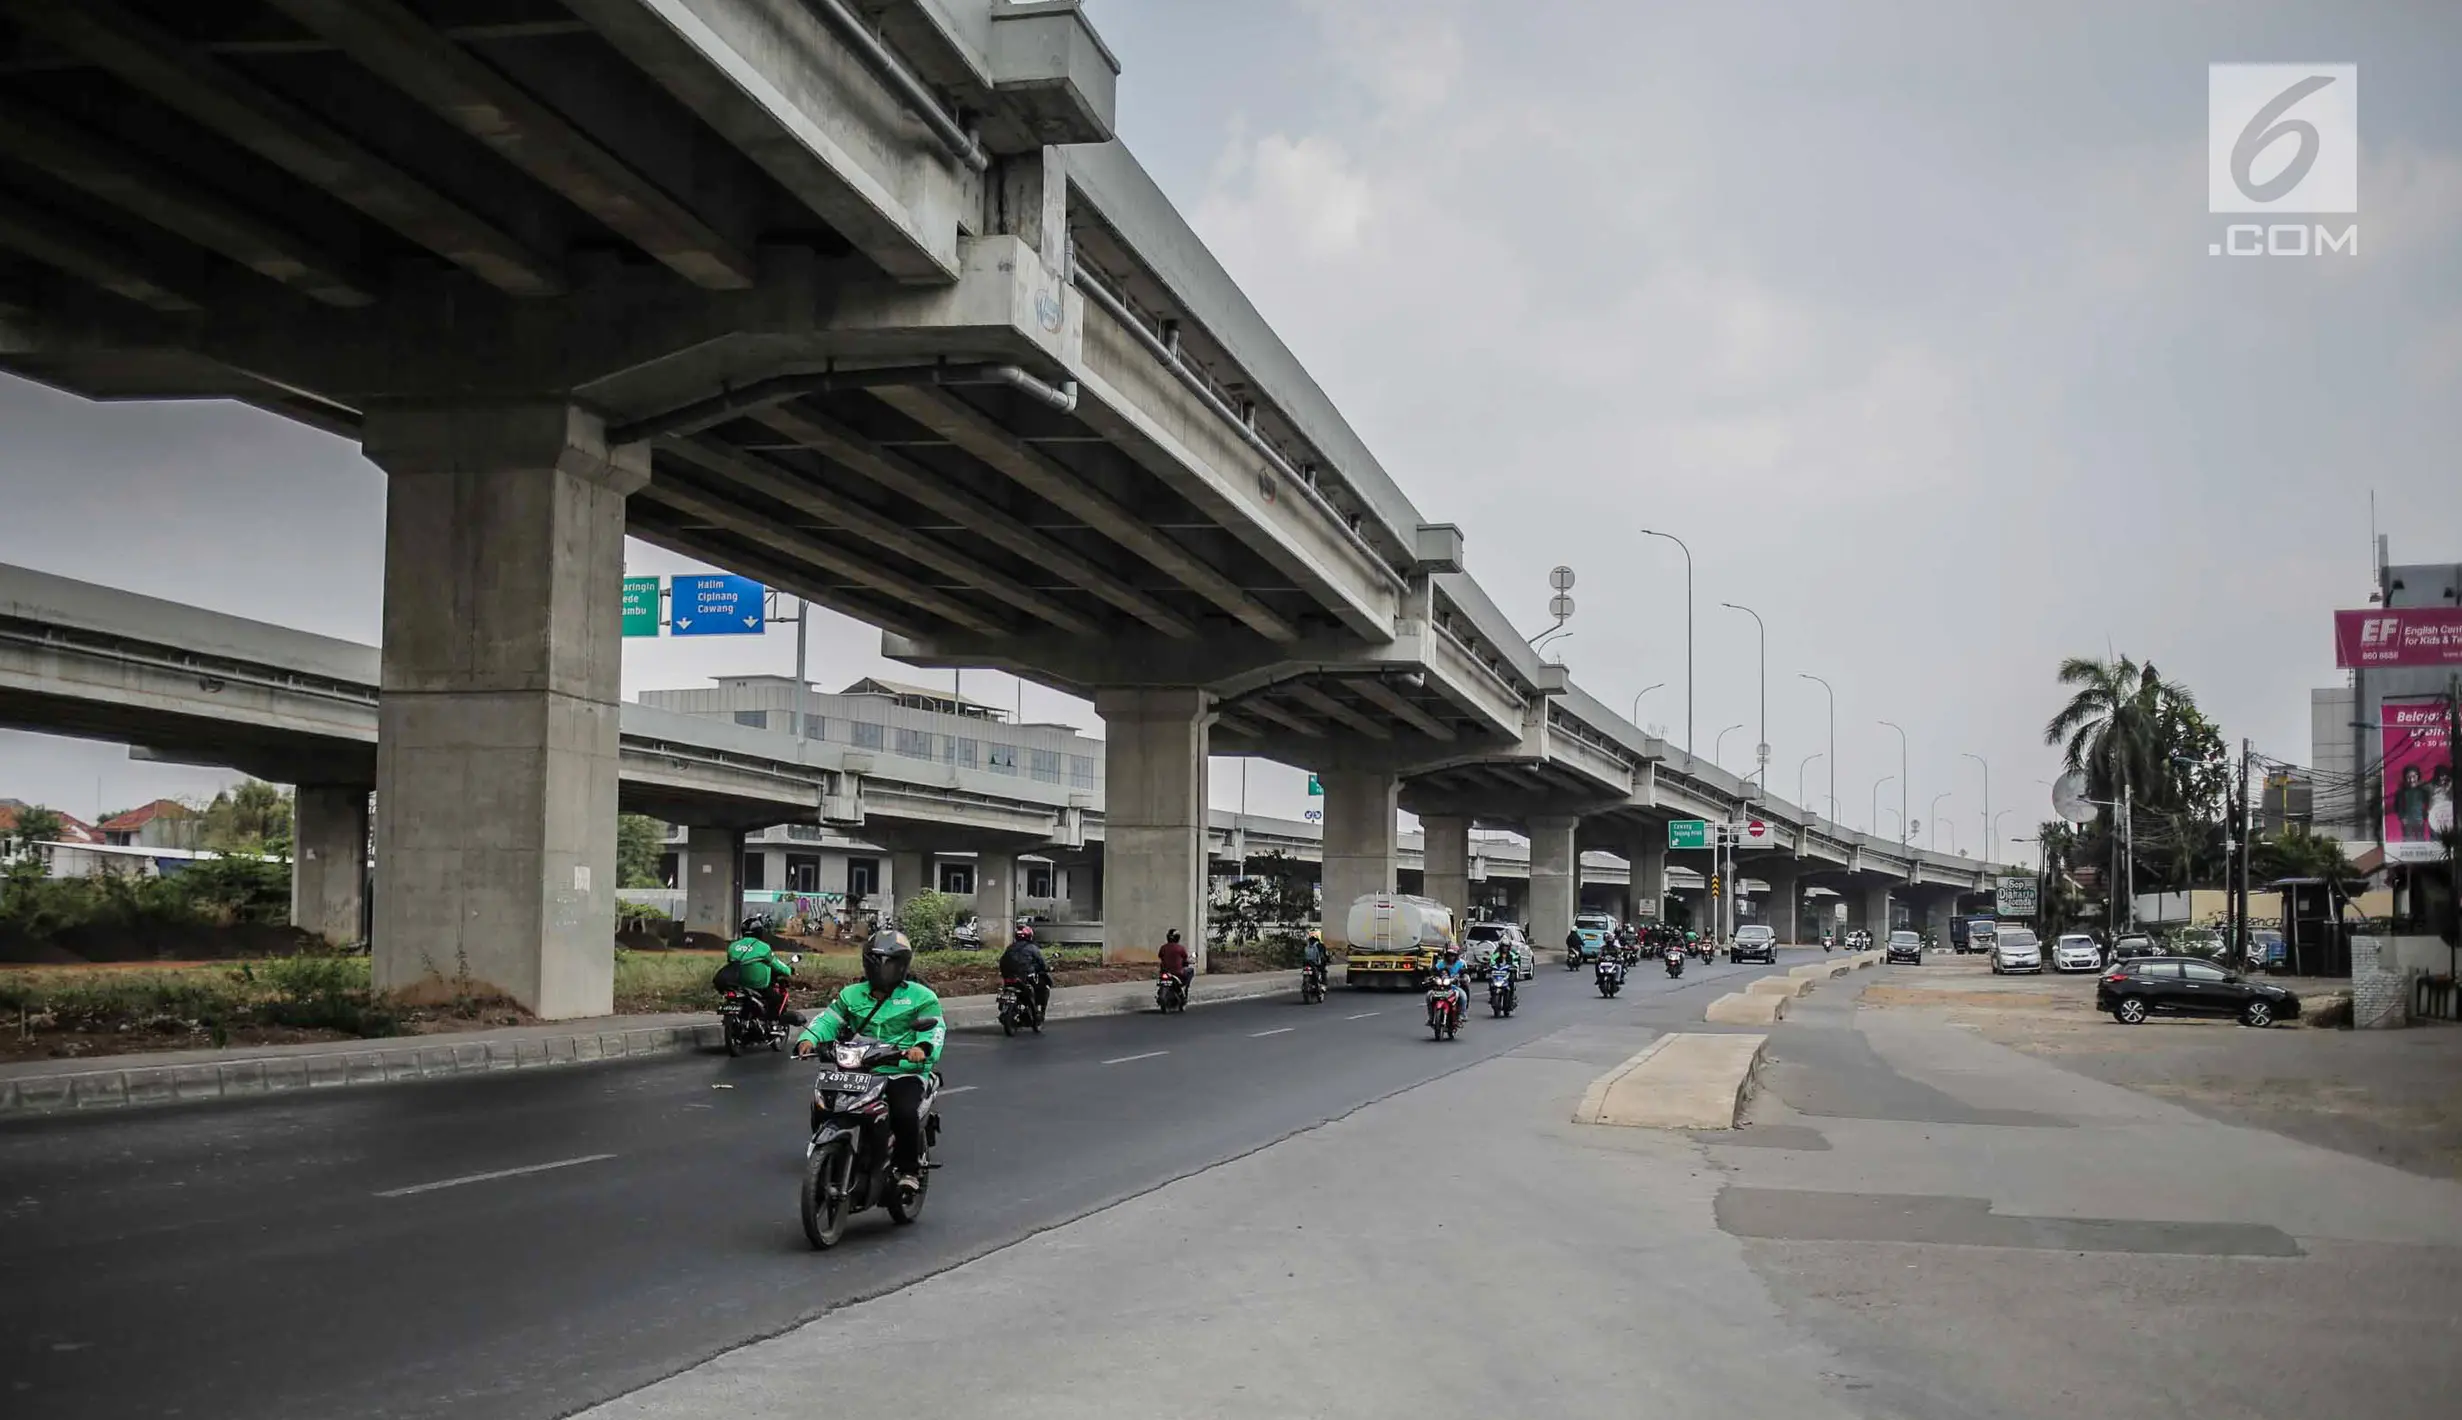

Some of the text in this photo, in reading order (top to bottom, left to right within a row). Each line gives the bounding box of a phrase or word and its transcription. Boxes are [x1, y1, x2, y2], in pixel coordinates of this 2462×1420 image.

[623, 582, 655, 593] aringin
[697, 580, 724, 589] Halim
[622, 594, 640, 603] ede
[697, 592, 738, 603] Cipinang
[621, 606, 647, 615] ambu
[2362, 618, 2399, 642] EF
[2404, 625, 2438, 636] English
[2404, 637, 2418, 646] for
[2419, 636, 2440, 645] Kids
